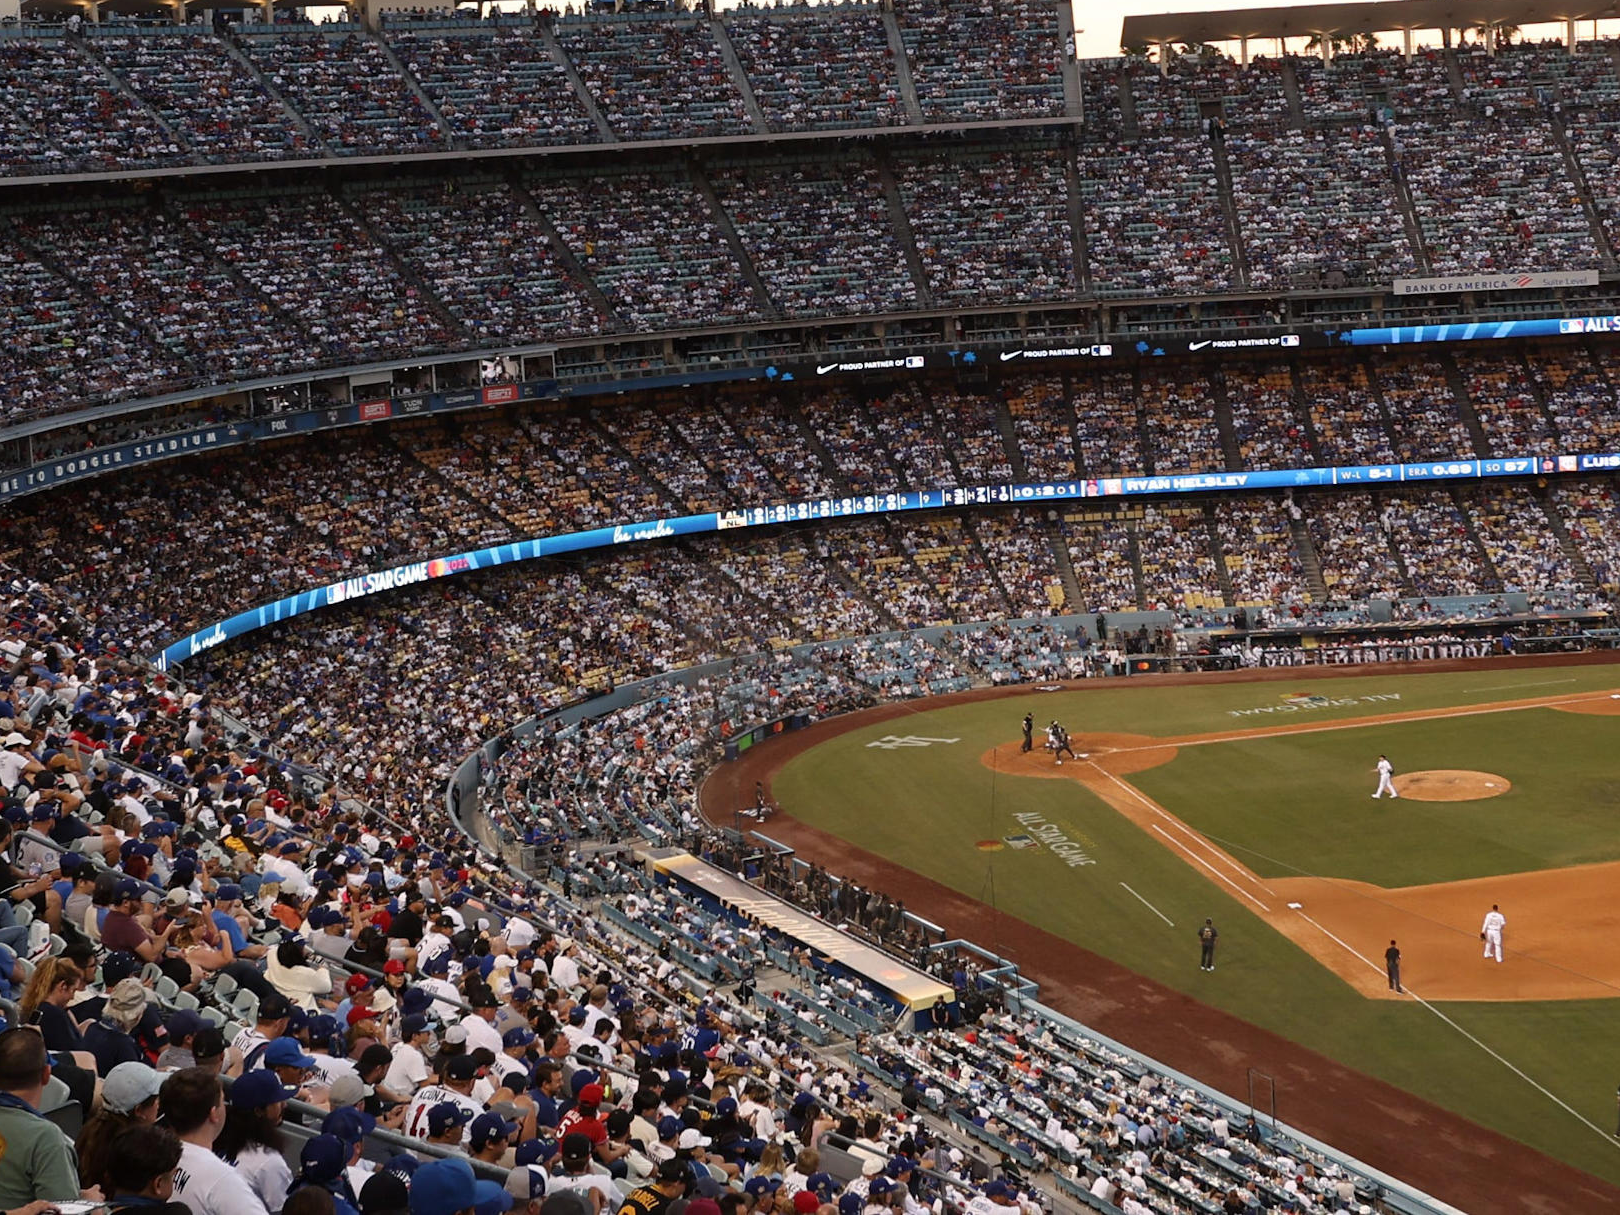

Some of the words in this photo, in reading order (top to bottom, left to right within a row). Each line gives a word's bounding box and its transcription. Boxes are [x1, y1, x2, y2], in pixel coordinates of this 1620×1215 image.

[1405, 283, 1438, 293] BANK
[1440, 283, 1455, 291] OF
[1457, 280, 1508, 290] AMERICA
[1212, 340, 1237, 348] PROUD
[1238, 338, 1269, 346] PARTNER
[1023, 350, 1048, 358] PROUD
[1049, 348, 1080, 356] PARTNER
[839, 363, 863, 371] PROUD
[864, 360, 894, 369] PARTNER
[487, 388, 512, 401] ESPN
[365, 403, 386, 417] ESPN
[271, 420, 287, 432] FOX
[27, 470, 45, 484] TO
[55, 452, 121, 476] DODGER
[134, 432, 217, 457] STADIUM
[1582, 455, 1620, 468] LUIS
[1408, 468, 1428, 476] ERA
[1431, 464, 1472, 476] 0.69
[1504, 461, 1528, 471] 57
[1126, 479, 1170, 491] RYAN
[1173, 475, 1248, 489] HELSLEY
